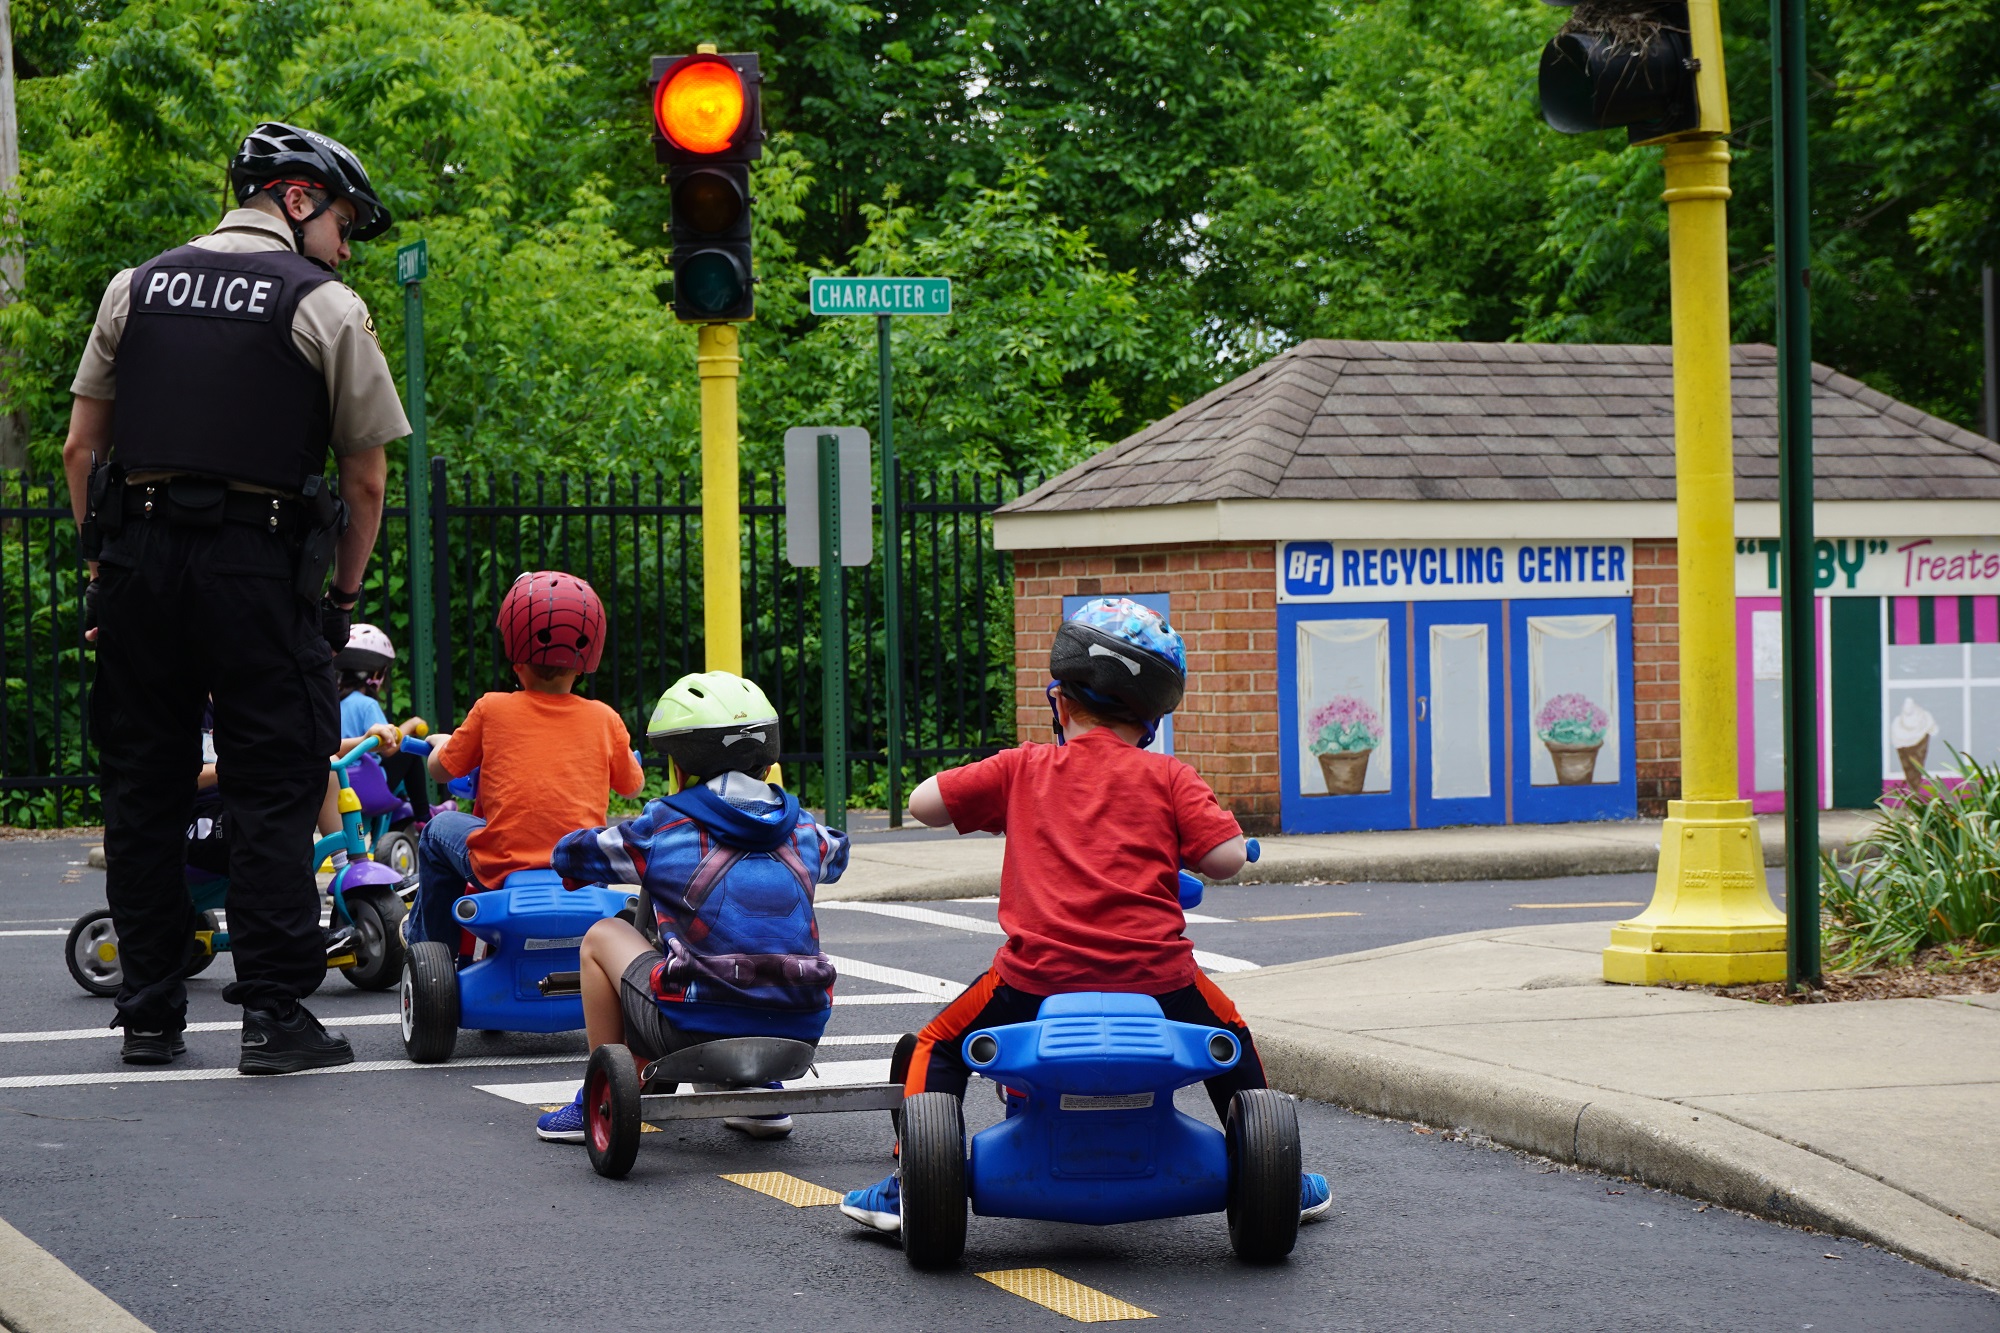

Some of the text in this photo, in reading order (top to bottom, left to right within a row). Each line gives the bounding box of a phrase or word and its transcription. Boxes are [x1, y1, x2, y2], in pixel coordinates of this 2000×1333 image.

[306, 132, 347, 159] POLICE
[144, 272, 272, 314] POLICE
[818, 284, 945, 308] CHARACTER CT
[1288, 546, 1626, 586] BFI RECYCLING CENTER
[1736, 539, 1999, 589] “TBY” Treats
[1684, 869, 1719, 879] TRAFFIC
